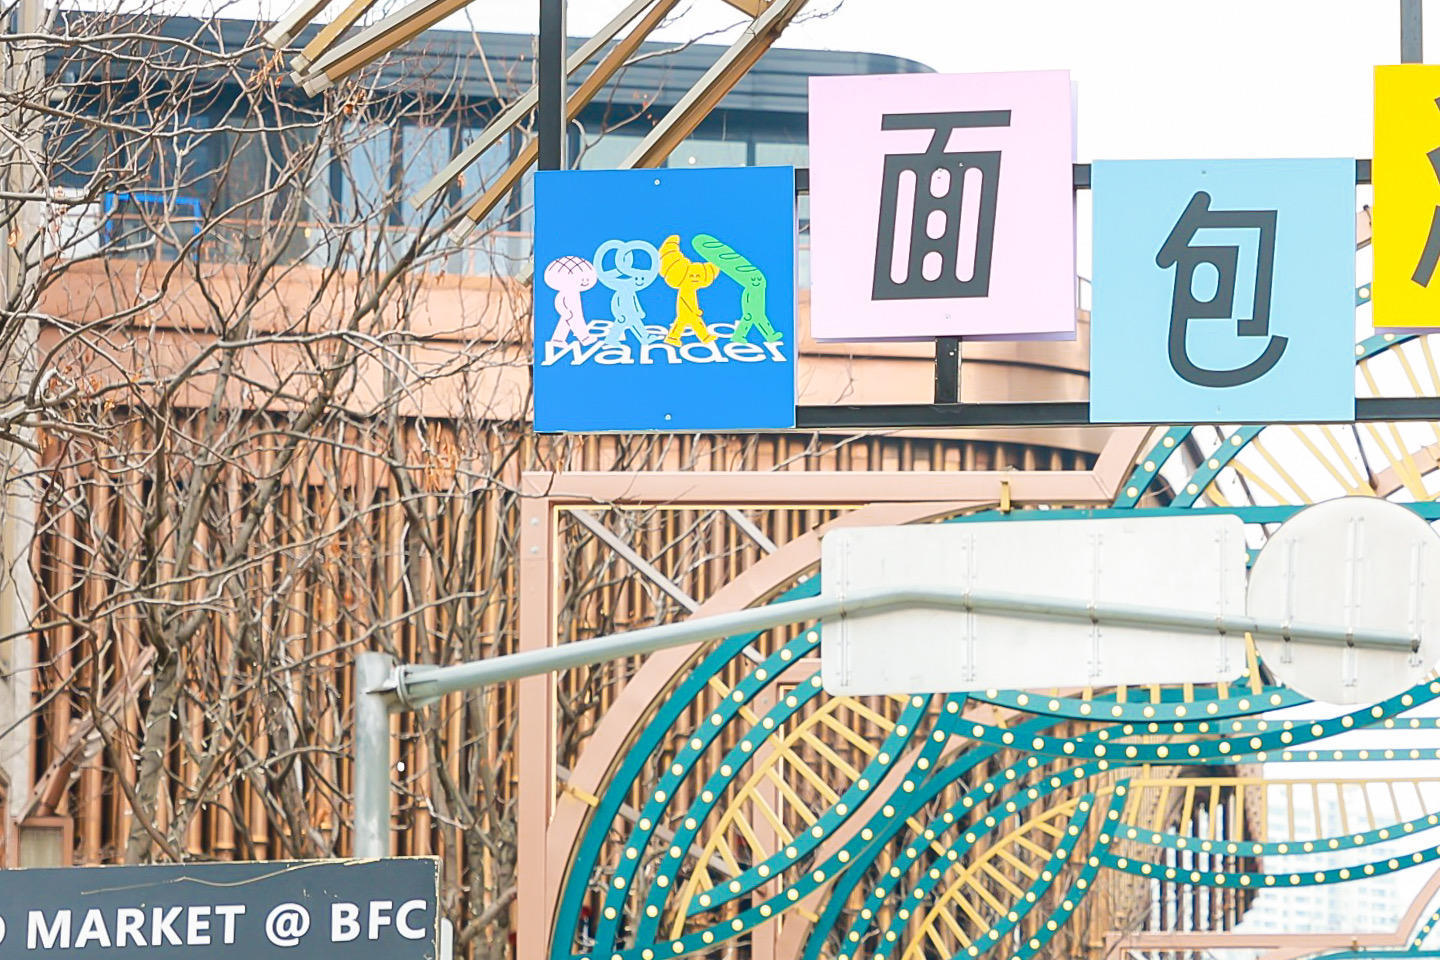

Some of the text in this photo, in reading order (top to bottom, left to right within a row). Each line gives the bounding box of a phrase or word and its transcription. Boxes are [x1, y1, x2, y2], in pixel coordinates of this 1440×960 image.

[541, 338, 788, 367] Wander
[26, 898, 428, 950] MARKET @ BFC
